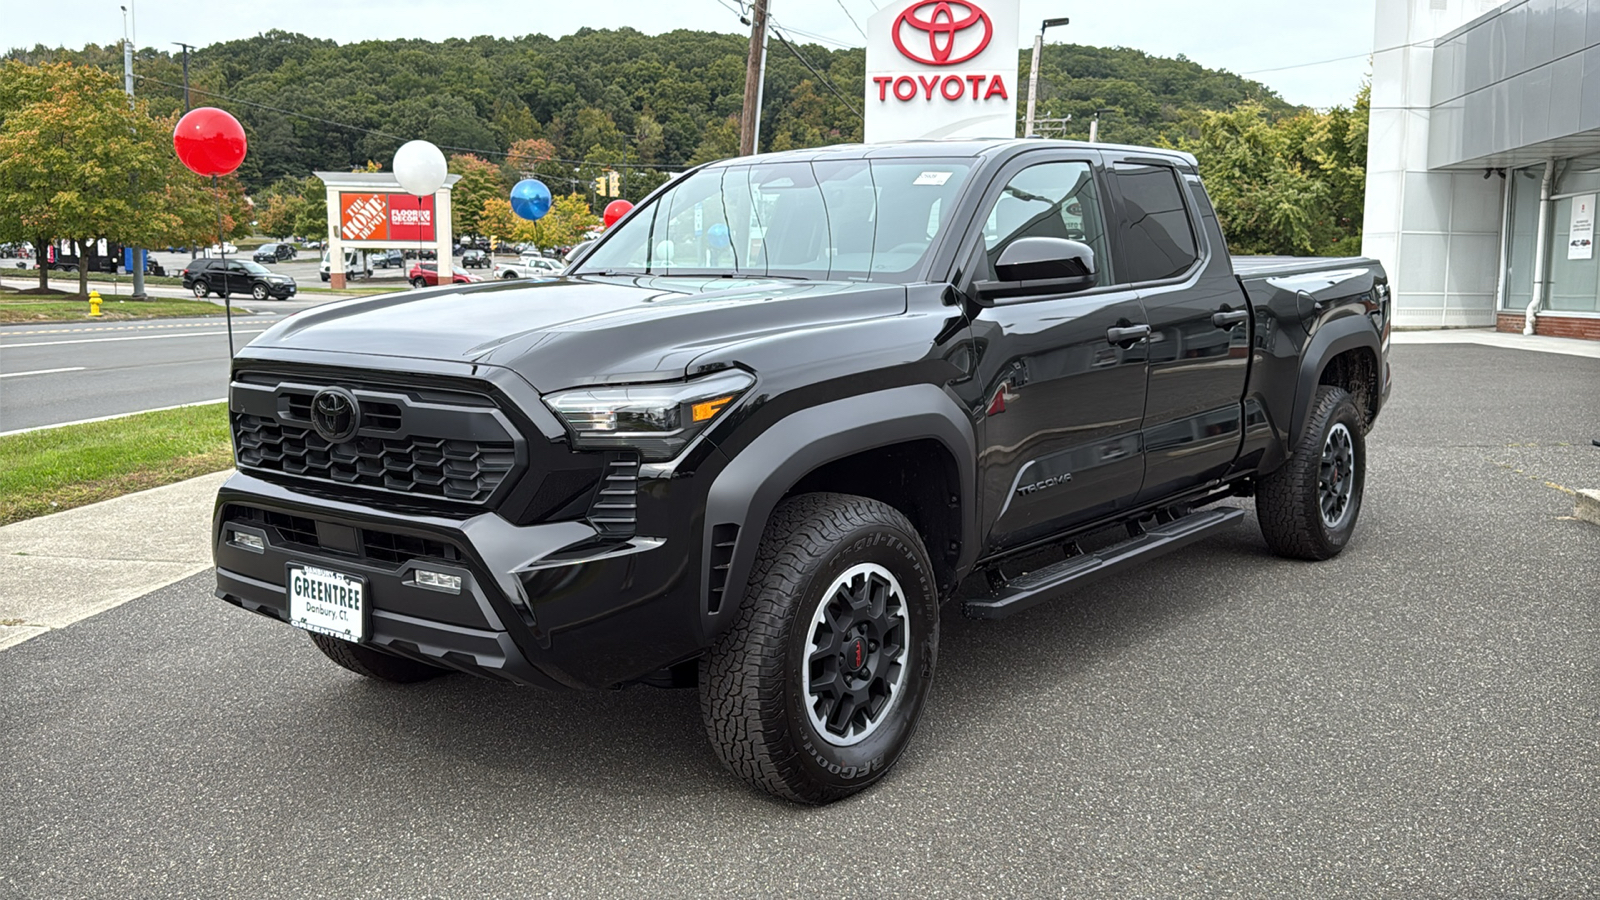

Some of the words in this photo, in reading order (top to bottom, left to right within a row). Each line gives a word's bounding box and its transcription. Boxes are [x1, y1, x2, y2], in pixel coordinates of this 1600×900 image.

[873, 74, 1008, 101] TOYOTA
[342, 196, 386, 239] HOME
[345, 197, 367, 217] THE
[359, 210, 386, 239] DEPOT
[1017, 472, 1073, 496] TACOMA
[294, 575, 360, 611] GREENTREE
[306, 601, 338, 621] Danbury,
[291, 620, 359, 643] GREENTREE
